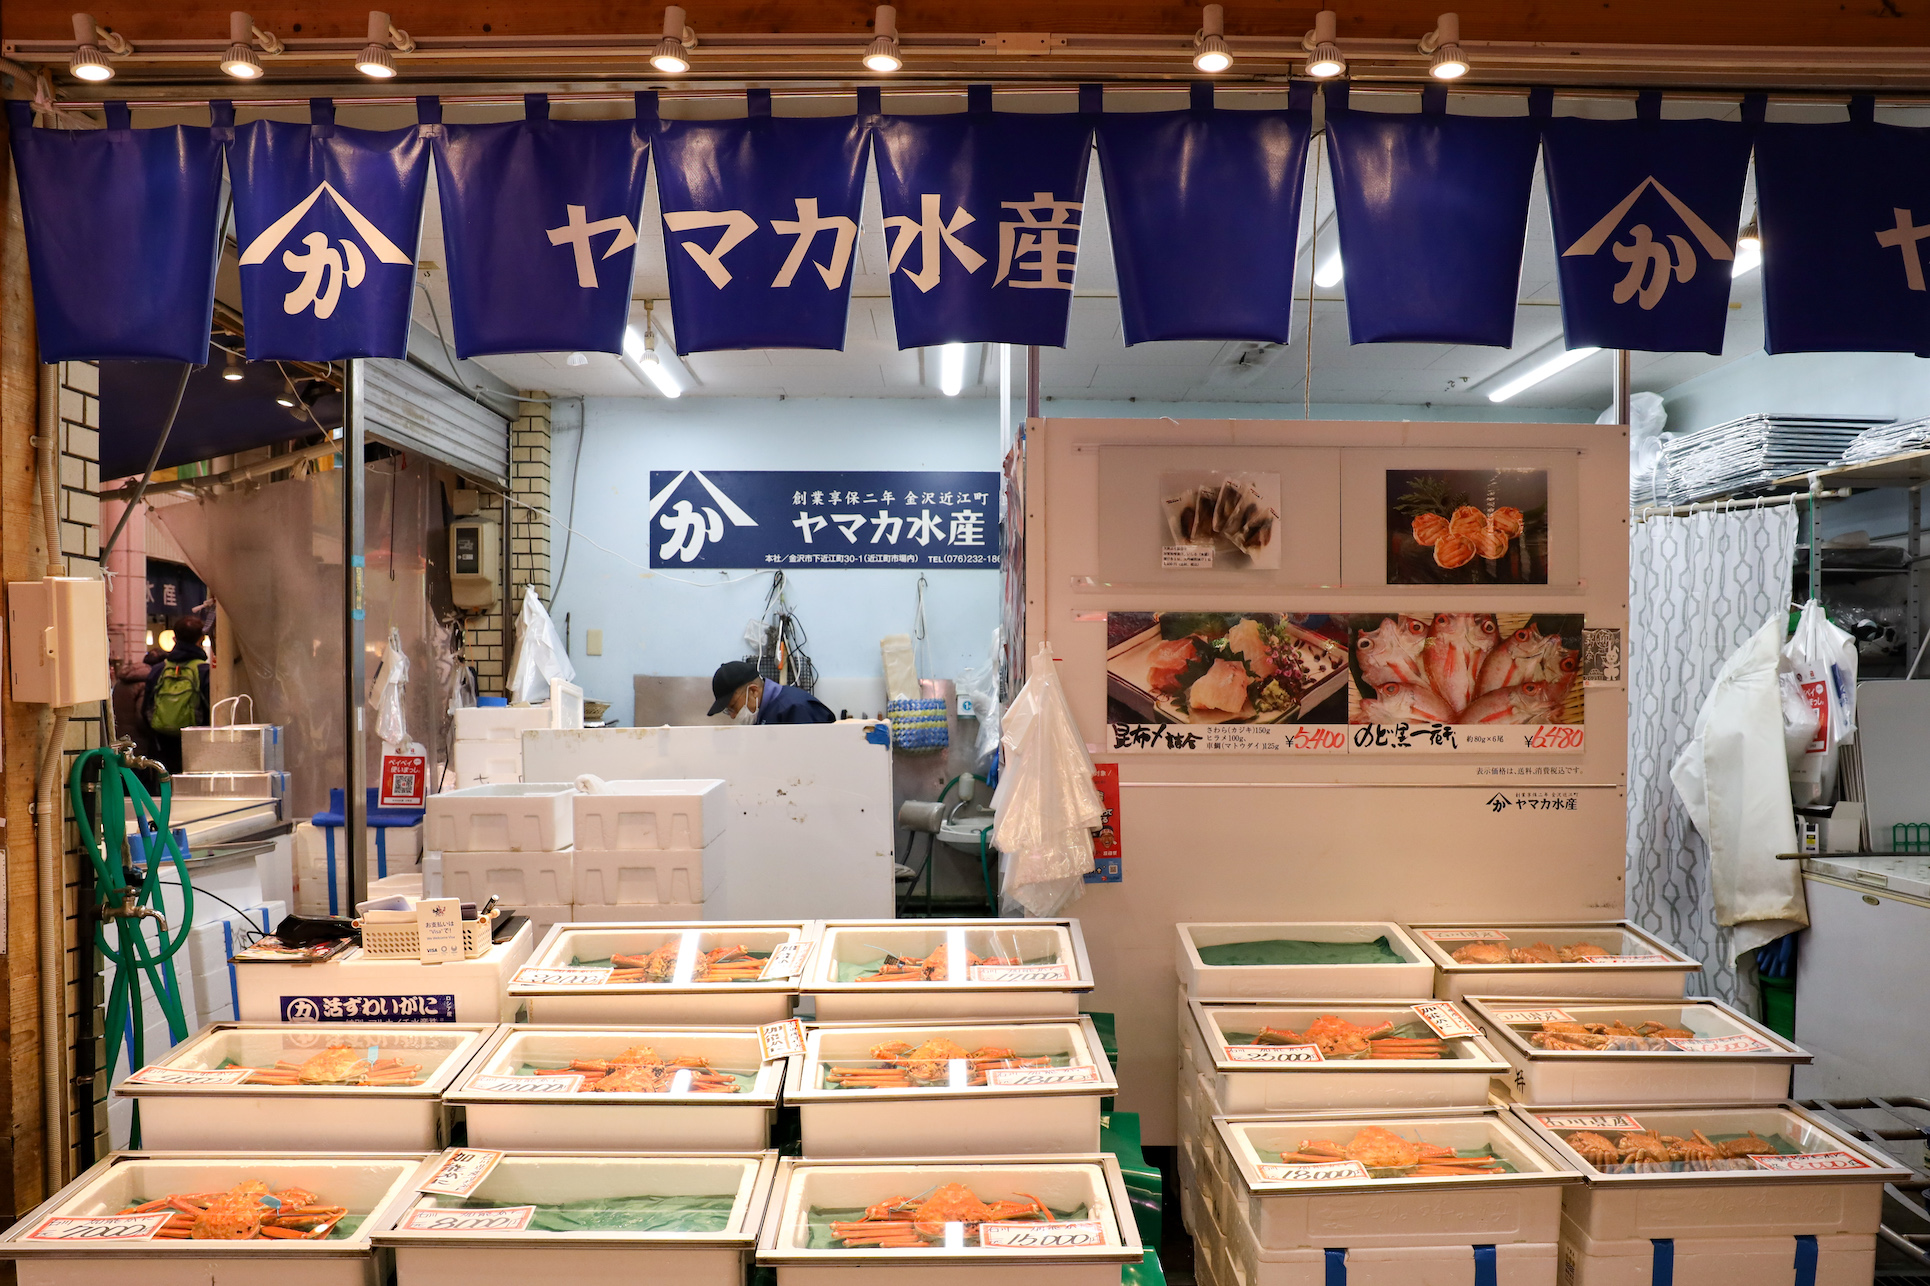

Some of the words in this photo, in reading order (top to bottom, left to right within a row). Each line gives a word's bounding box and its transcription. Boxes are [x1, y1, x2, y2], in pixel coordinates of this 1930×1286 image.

[545, 192, 1083, 294] ヤマカ水産
[1612, 223, 1698, 311] か
[282, 231, 367, 320] か
[792, 490, 896, 506] 創業享保二年
[904, 490, 989, 506] 金沢近江町
[658, 499, 724, 562] か
[791, 508, 986, 546] ヤマカ水産
[1515, 798, 1578, 811] ヤマカ水産
[322, 996, 439, 1018] 活ずわいがに
